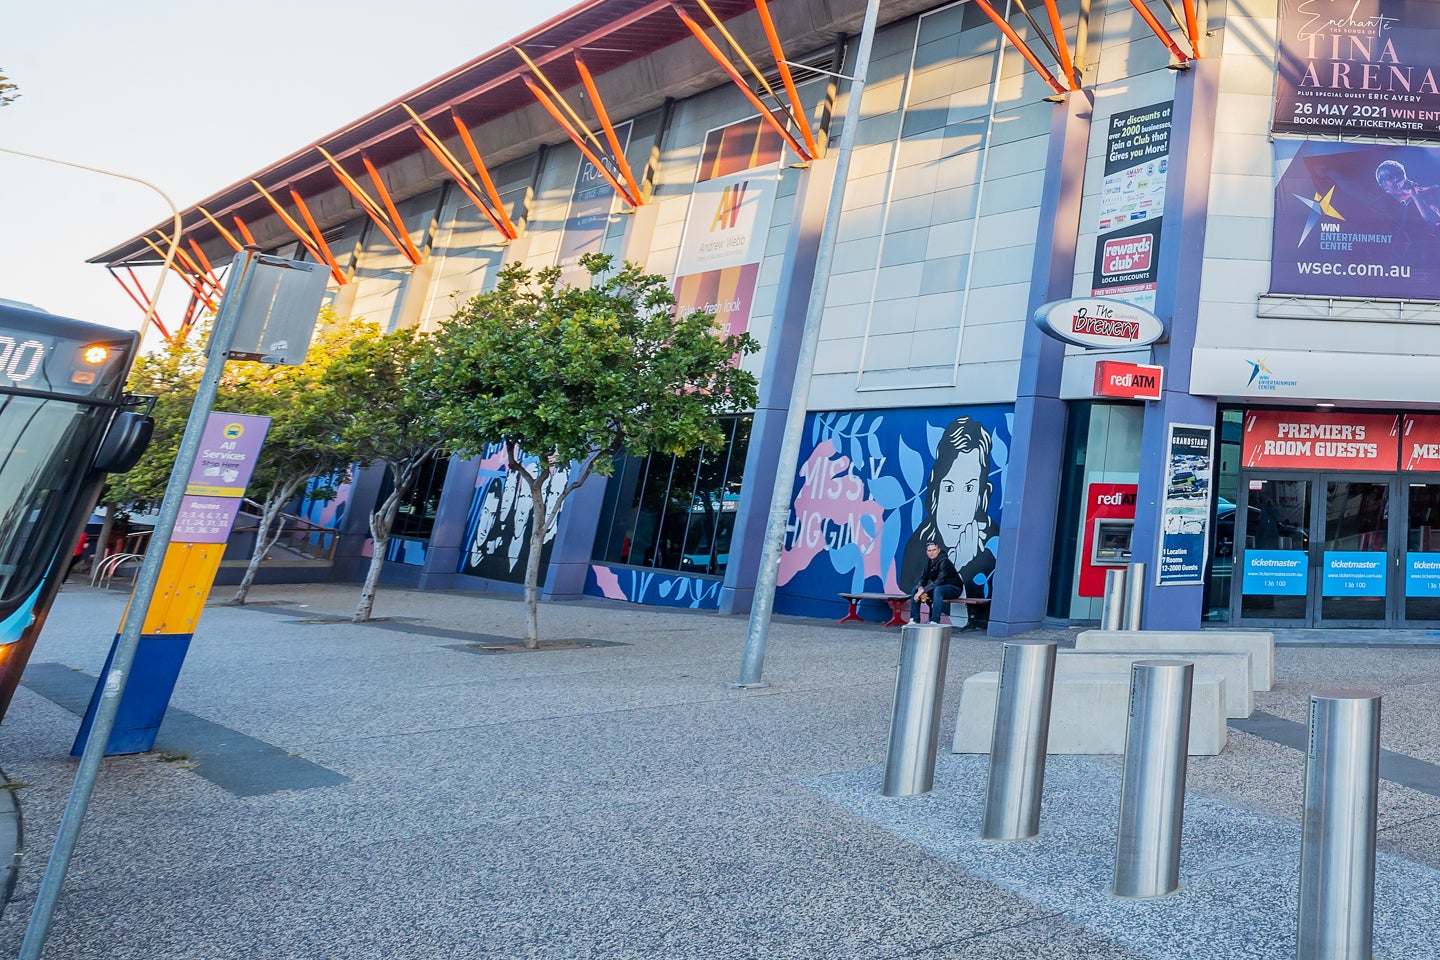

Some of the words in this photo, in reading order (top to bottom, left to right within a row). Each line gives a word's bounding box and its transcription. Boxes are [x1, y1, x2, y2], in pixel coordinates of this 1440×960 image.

[1300, 33, 1402, 64] TINA
[1368, 93, 1389, 101] ERIC
[1391, 94, 1422, 103] AVERY
[1113, 118, 1125, 129] For
[1126, 110, 1161, 126] discounts
[1161, 108, 1171, 118] at
[1294, 103, 1313, 115] 26
[1317, 104, 1349, 116] MAY
[1352, 105, 1388, 118] 2021
[1390, 108, 1416, 120] WIN
[1108, 131, 1121, 141] over
[1121, 124, 1141, 138] 2000
[1141, 121, 1173, 133] businesses,
[1293, 116, 1319, 126] BOOK
[1321, 117, 1344, 127] NOW
[1346, 118, 1358, 127] AT
[1359, 119, 1424, 131] TICKETMASTER
[1111, 140, 1125, 153] join
[1126, 139, 1132, 148] a
[1133, 134, 1151, 146] Club
[1151, 131, 1168, 142] that
[1109, 151, 1129, 162] Gives
[1129, 149, 1144, 161] you
[1144, 141, 1168, 155] More!
[1321, 223, 1340, 233] WIN
[699, 239, 724, 254] Andrew
[726, 235, 746, 248] Webb
[1320, 232, 1392, 244] ENTERTAINMENT
[1320, 241, 1353, 251] CENTRE
[1105, 238, 1151, 257] rewards
[1109, 255, 1133, 272] club
[1297, 261, 1411, 278] wsec.com.au
[1101, 274, 1118, 284] LOCAL
[1119, 272, 1150, 283] DISCOUNTS
[1117, 285, 1146, 294] MEMBERSHIP
[703, 301, 722, 315] fresh
[723, 297, 741, 312] look
[1096, 304, 1113, 319] The
[1075, 307, 1139, 342] Brewery
[1110, 373, 1155, 389] rediATM
[1278, 423, 1366, 440] PREMIER'S
[220, 442, 237, 450] All
[1172, 436, 1208, 446] GRANDSTAND
[1263, 440, 1312, 456] ROOM
[1315, 442, 1378, 458] GUESTS
[202, 449, 246, 460] Services
[190, 502, 221, 510] Routes
[1251, 558, 1298, 567] ticketmaster
[1330, 560, 1377, 569] ticketmaster
